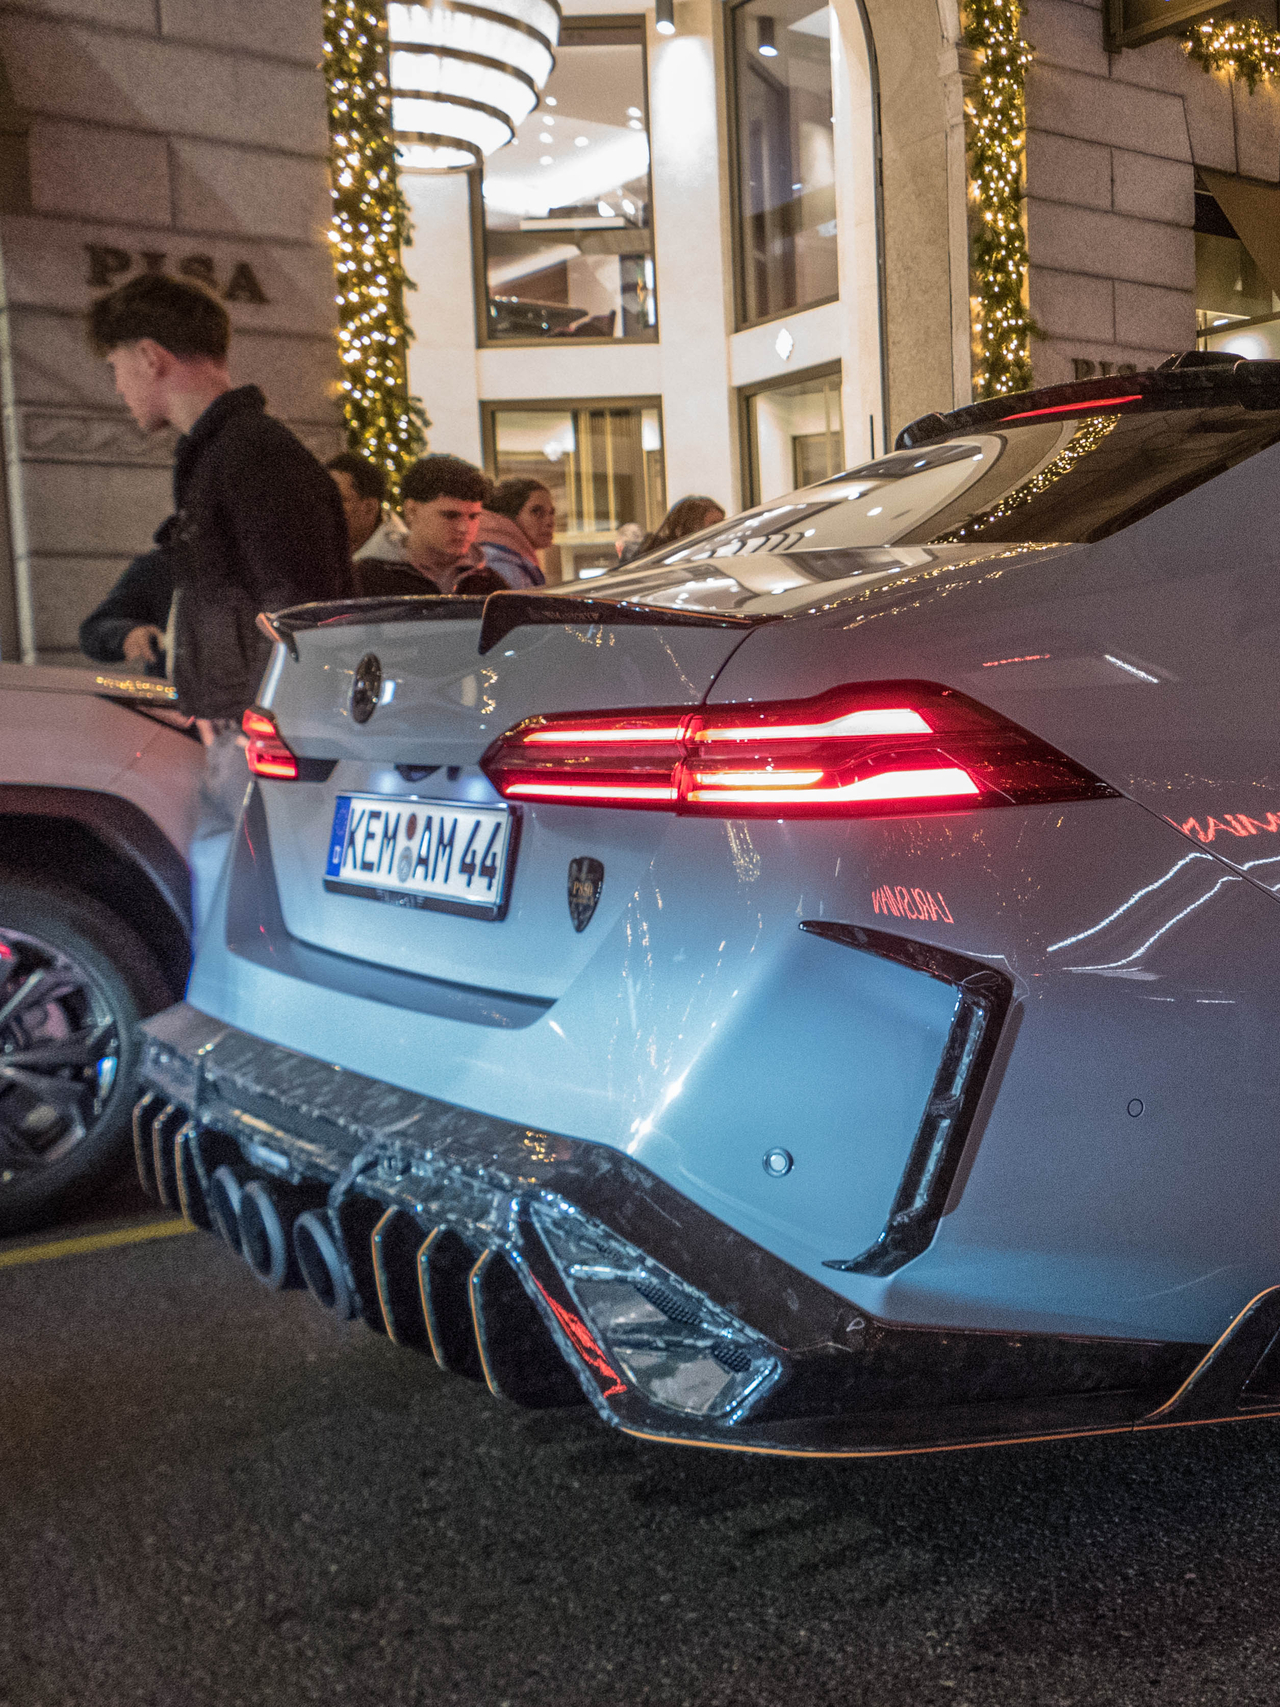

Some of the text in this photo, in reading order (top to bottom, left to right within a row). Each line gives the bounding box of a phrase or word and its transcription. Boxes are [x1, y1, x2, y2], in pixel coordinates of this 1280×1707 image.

[342, 807, 401, 875] KEM
[412, 815, 458, 884] AM
[459, 819, 503, 892] 44
